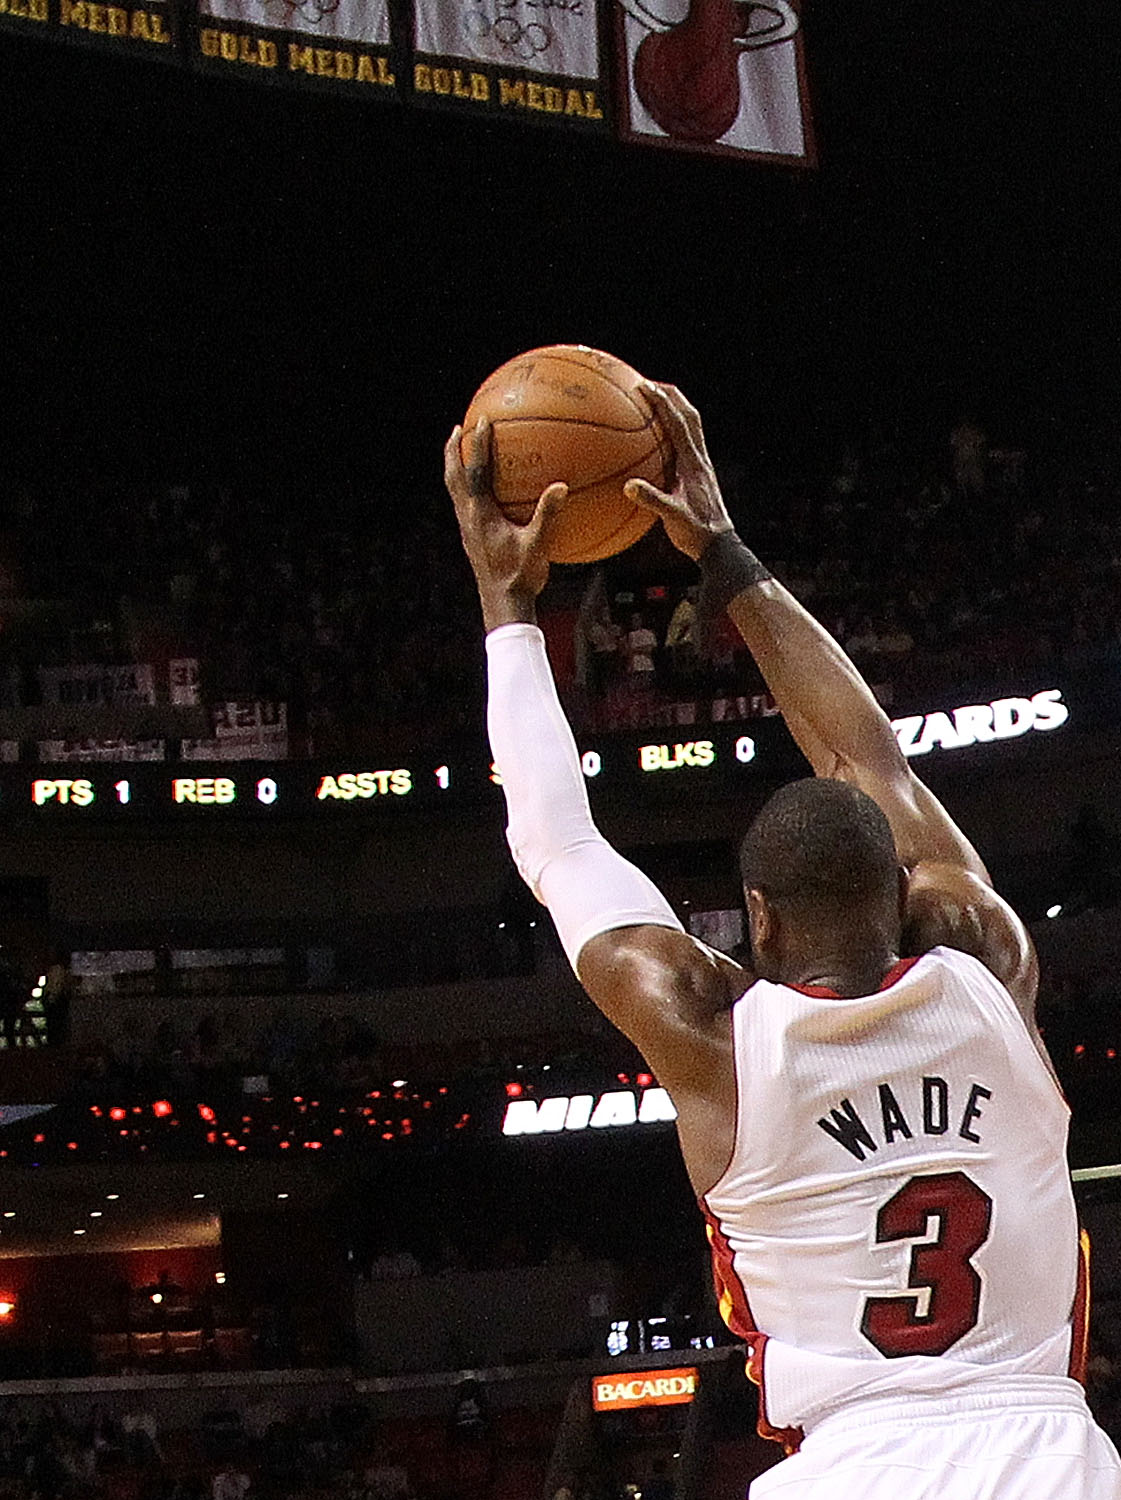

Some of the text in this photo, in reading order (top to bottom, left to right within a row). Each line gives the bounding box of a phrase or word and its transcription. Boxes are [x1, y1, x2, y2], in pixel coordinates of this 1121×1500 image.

[60, 0, 170, 43] MEDAL
[201, 28, 396, 87] GOLD MEDAL
[414, 63, 604, 119] GOLD MEDAL
[32, 736, 756, 806] PTS 1 REB 0 ASSTS 1 0 BLKS 0
[817, 1077, 992, 1161] WADE
[859, 1170, 994, 1359] 3
[597, 1375, 696, 1402] BACARDI
